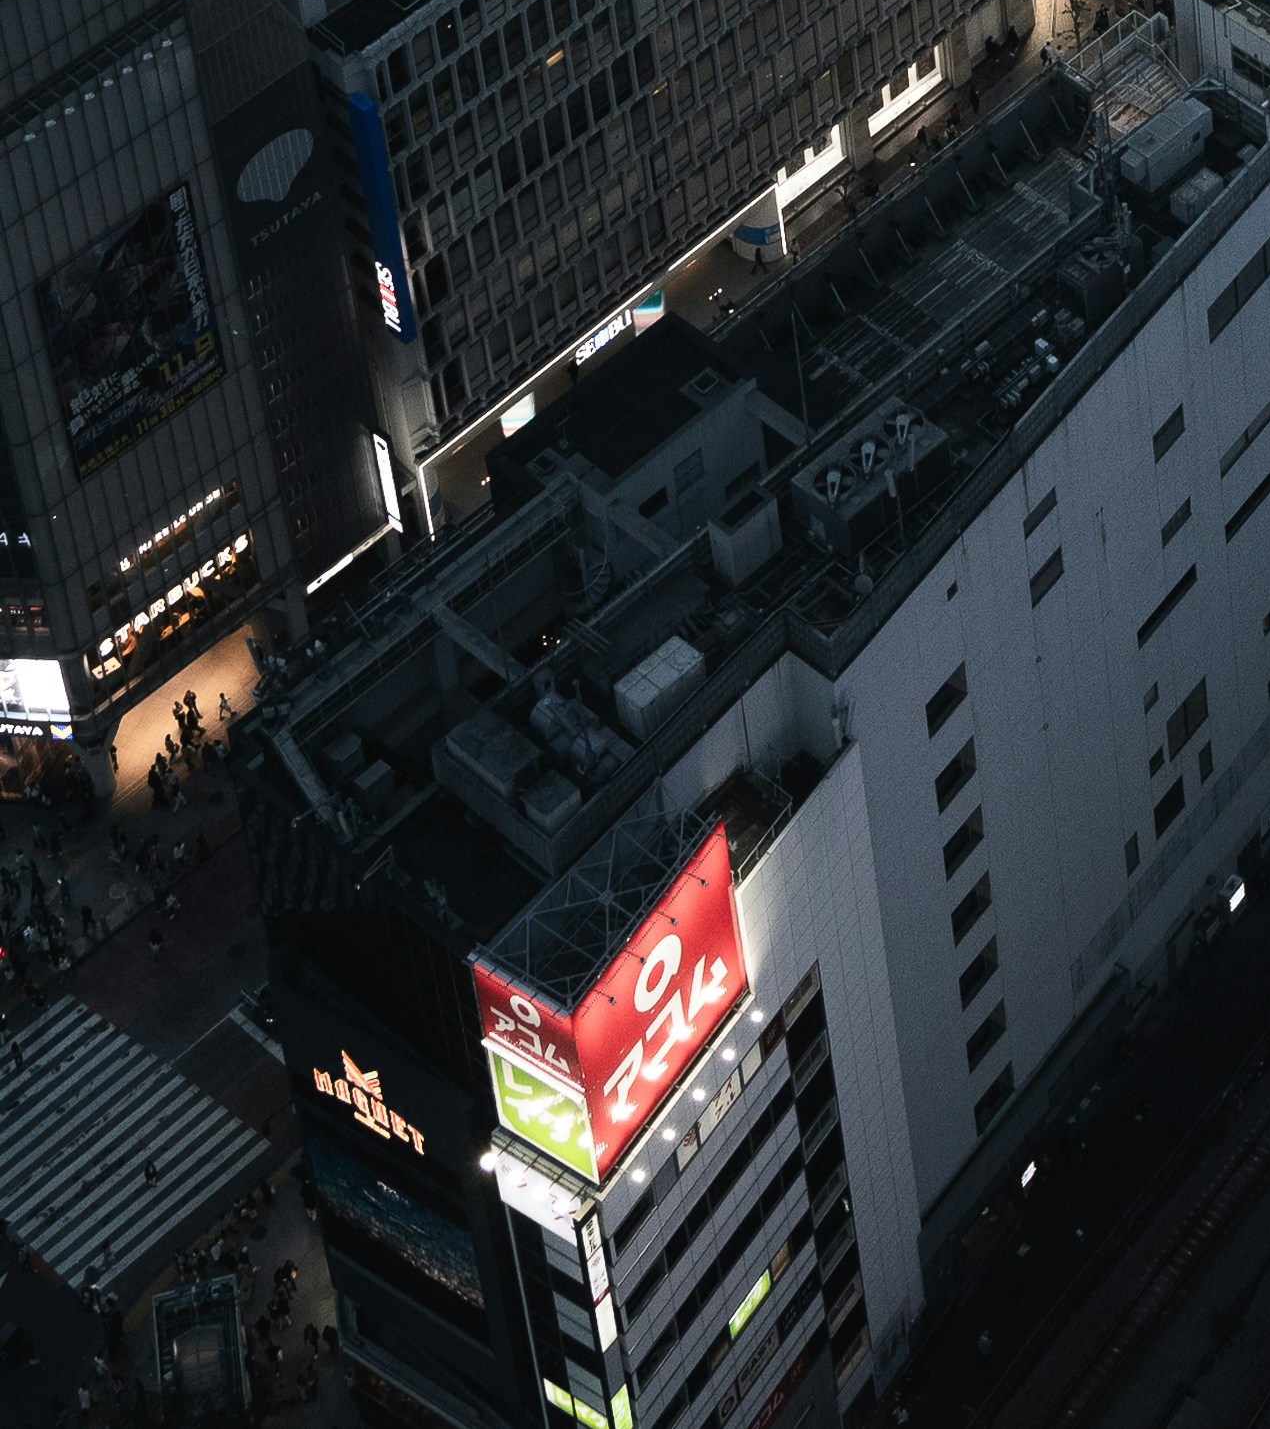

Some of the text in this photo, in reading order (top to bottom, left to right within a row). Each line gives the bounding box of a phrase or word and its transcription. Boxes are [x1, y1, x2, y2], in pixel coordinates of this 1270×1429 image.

[249, 191, 323, 248] TSUTAYA
[374, 261, 402, 333] SEIBU
[574, 308, 633, 366] SEIBU
[99, 532, 250, 658] STARBUCKS
[490, 1005, 570, 1075] アコム
[603, 953, 729, 1124] アコム
